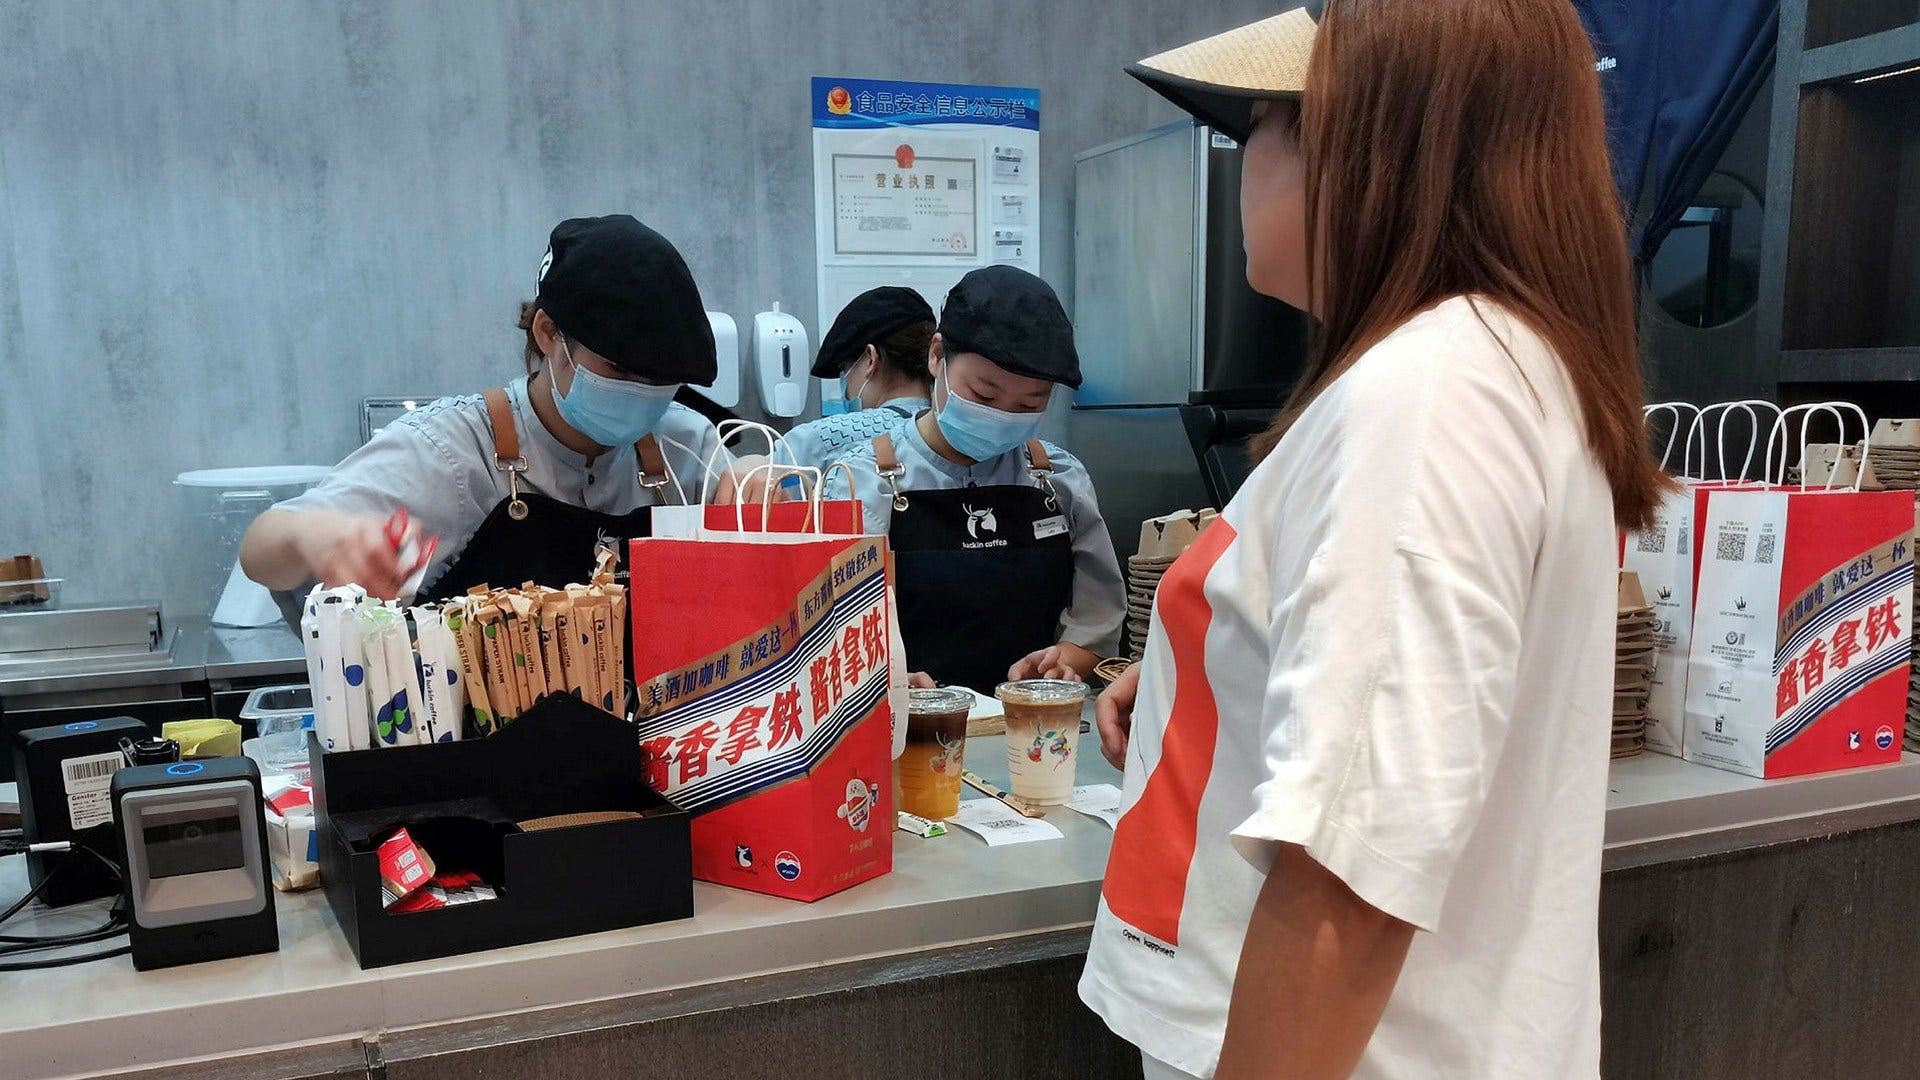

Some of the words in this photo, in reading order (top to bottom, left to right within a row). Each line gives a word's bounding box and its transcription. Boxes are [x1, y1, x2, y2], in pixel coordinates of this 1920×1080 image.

[1596, 57, 1616, 71] offee
[856, 90, 1027, 120] 食品安全信息公示栏
[876, 173, 935, 189] 营业执照
[985, 539, 1007, 548] coffee
[1833, 539, 1906, 594] 就爱这一杯
[460, 649, 473, 674] STRAW
[526, 654, 534, 674] coffee
[810, 607, 885, 725] 酱香拿铁
[1776, 596, 1901, 719] 酱香拿铁
[648, 653, 730, 710] 美酒加咖啡
[429, 702, 437, 725] coffee
[639, 682, 803, 792] 酱香拿铁
[1122, 929, 1141, 943] Open
